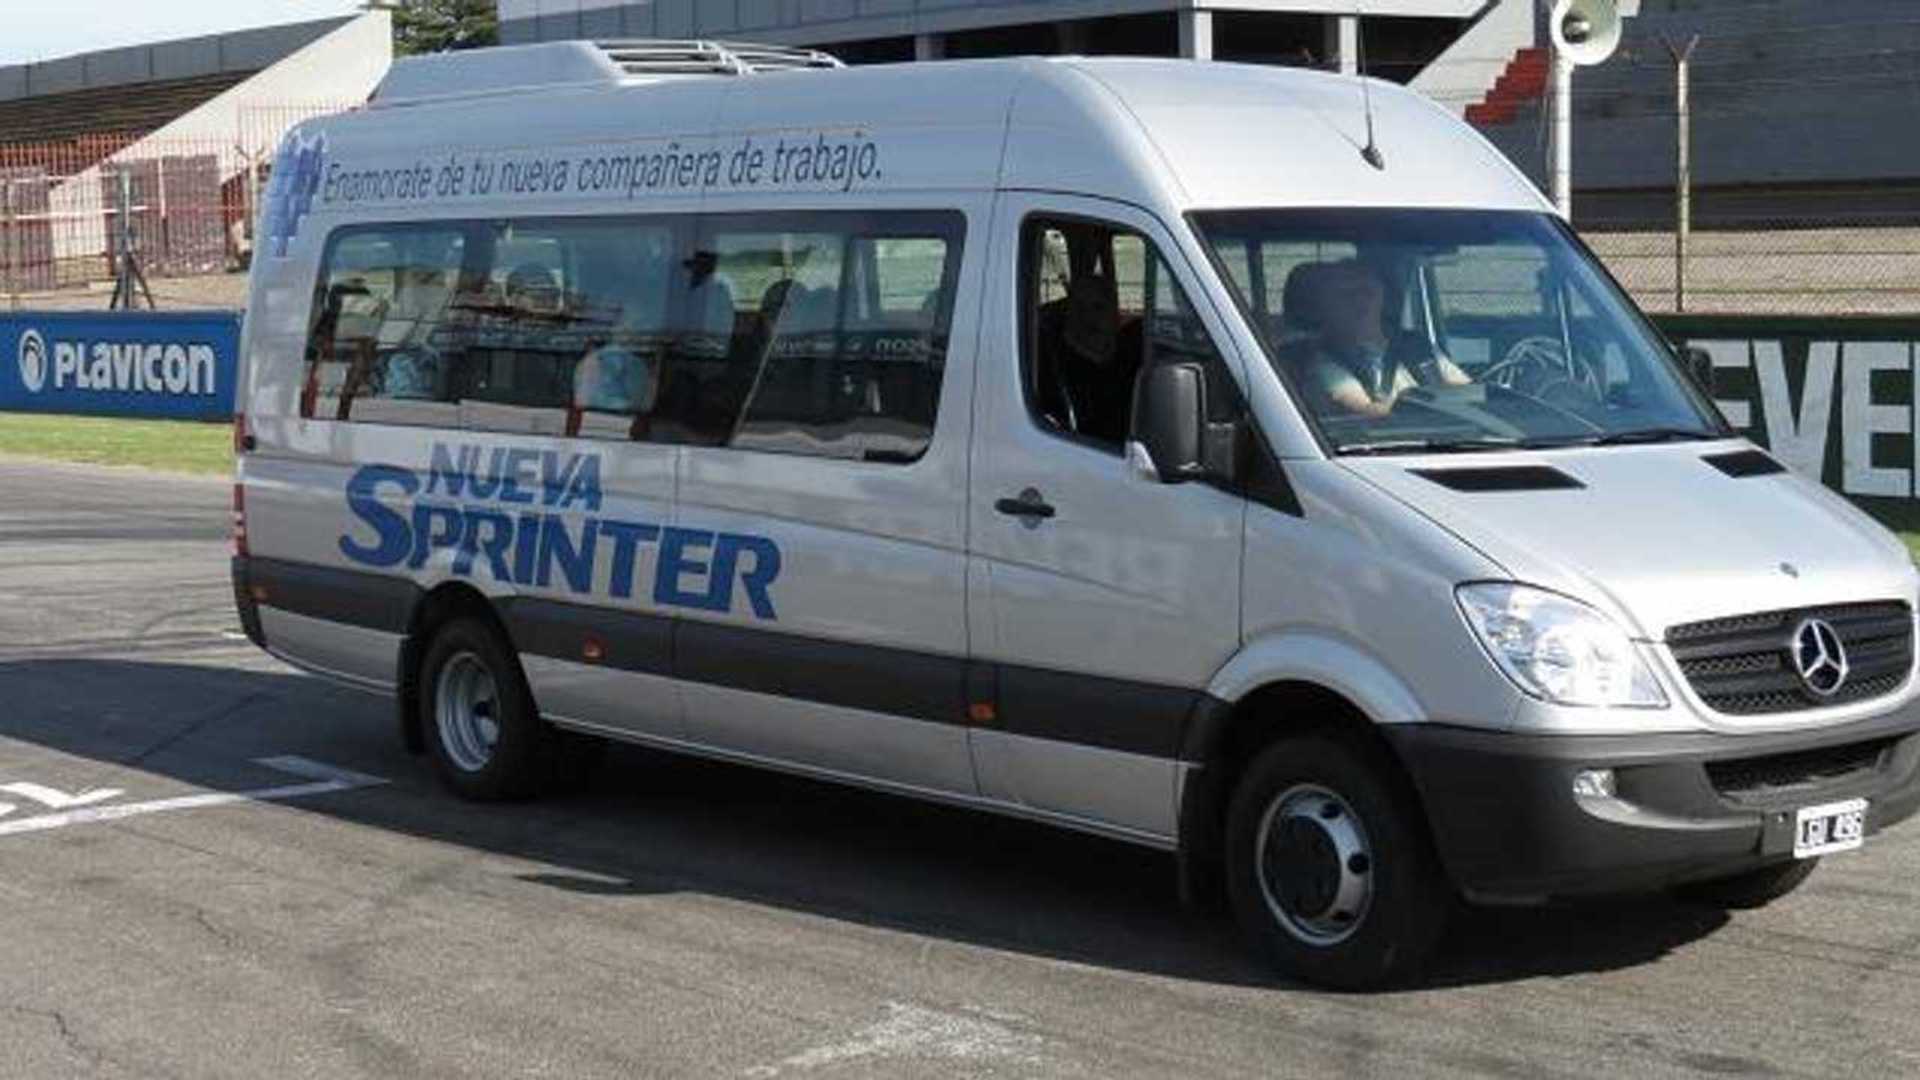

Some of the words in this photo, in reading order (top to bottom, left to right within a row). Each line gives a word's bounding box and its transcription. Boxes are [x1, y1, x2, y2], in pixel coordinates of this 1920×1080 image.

[325, 162, 432, 201] Enamorate
[436, 156, 465, 196] de
[470, 158, 494, 195] tu
[502, 159, 569, 193] nueva
[577, 142, 722, 200] compañera
[729, 138, 765, 184] de
[773, 131, 882, 192] trabajo.
[426, 443, 602, 511] NUEVA
[338, 464, 783, 621] SPRINTER
